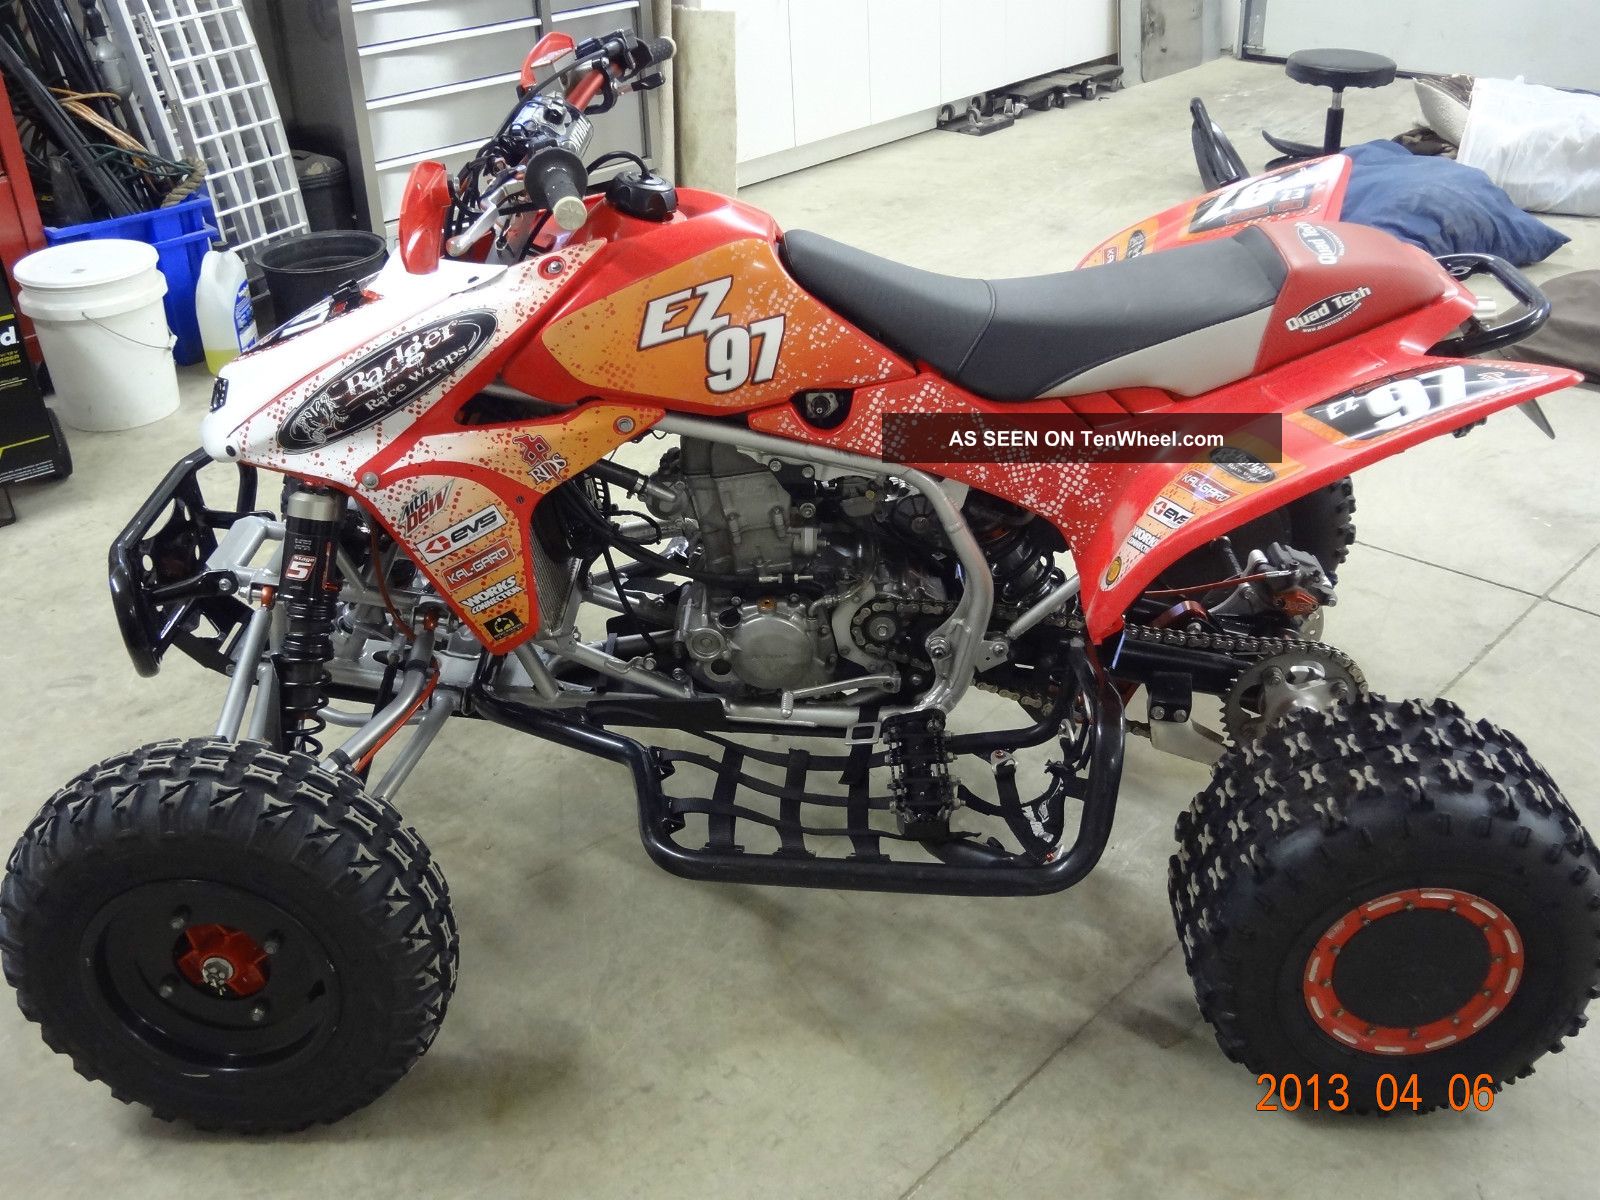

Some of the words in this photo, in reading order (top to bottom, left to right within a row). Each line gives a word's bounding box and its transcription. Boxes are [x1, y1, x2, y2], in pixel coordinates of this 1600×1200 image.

[637, 274, 733, 351] EZ
[1286, 302, 1331, 331] Quad
[1331, 287, 1372, 309] Tech
[705, 313, 786, 395] 97
[365, 384, 407, 411] Race
[1366, 364, 1467, 429] 97
[287, 560, 312, 579] 5
[460, 575, 516, 607] WORKS
